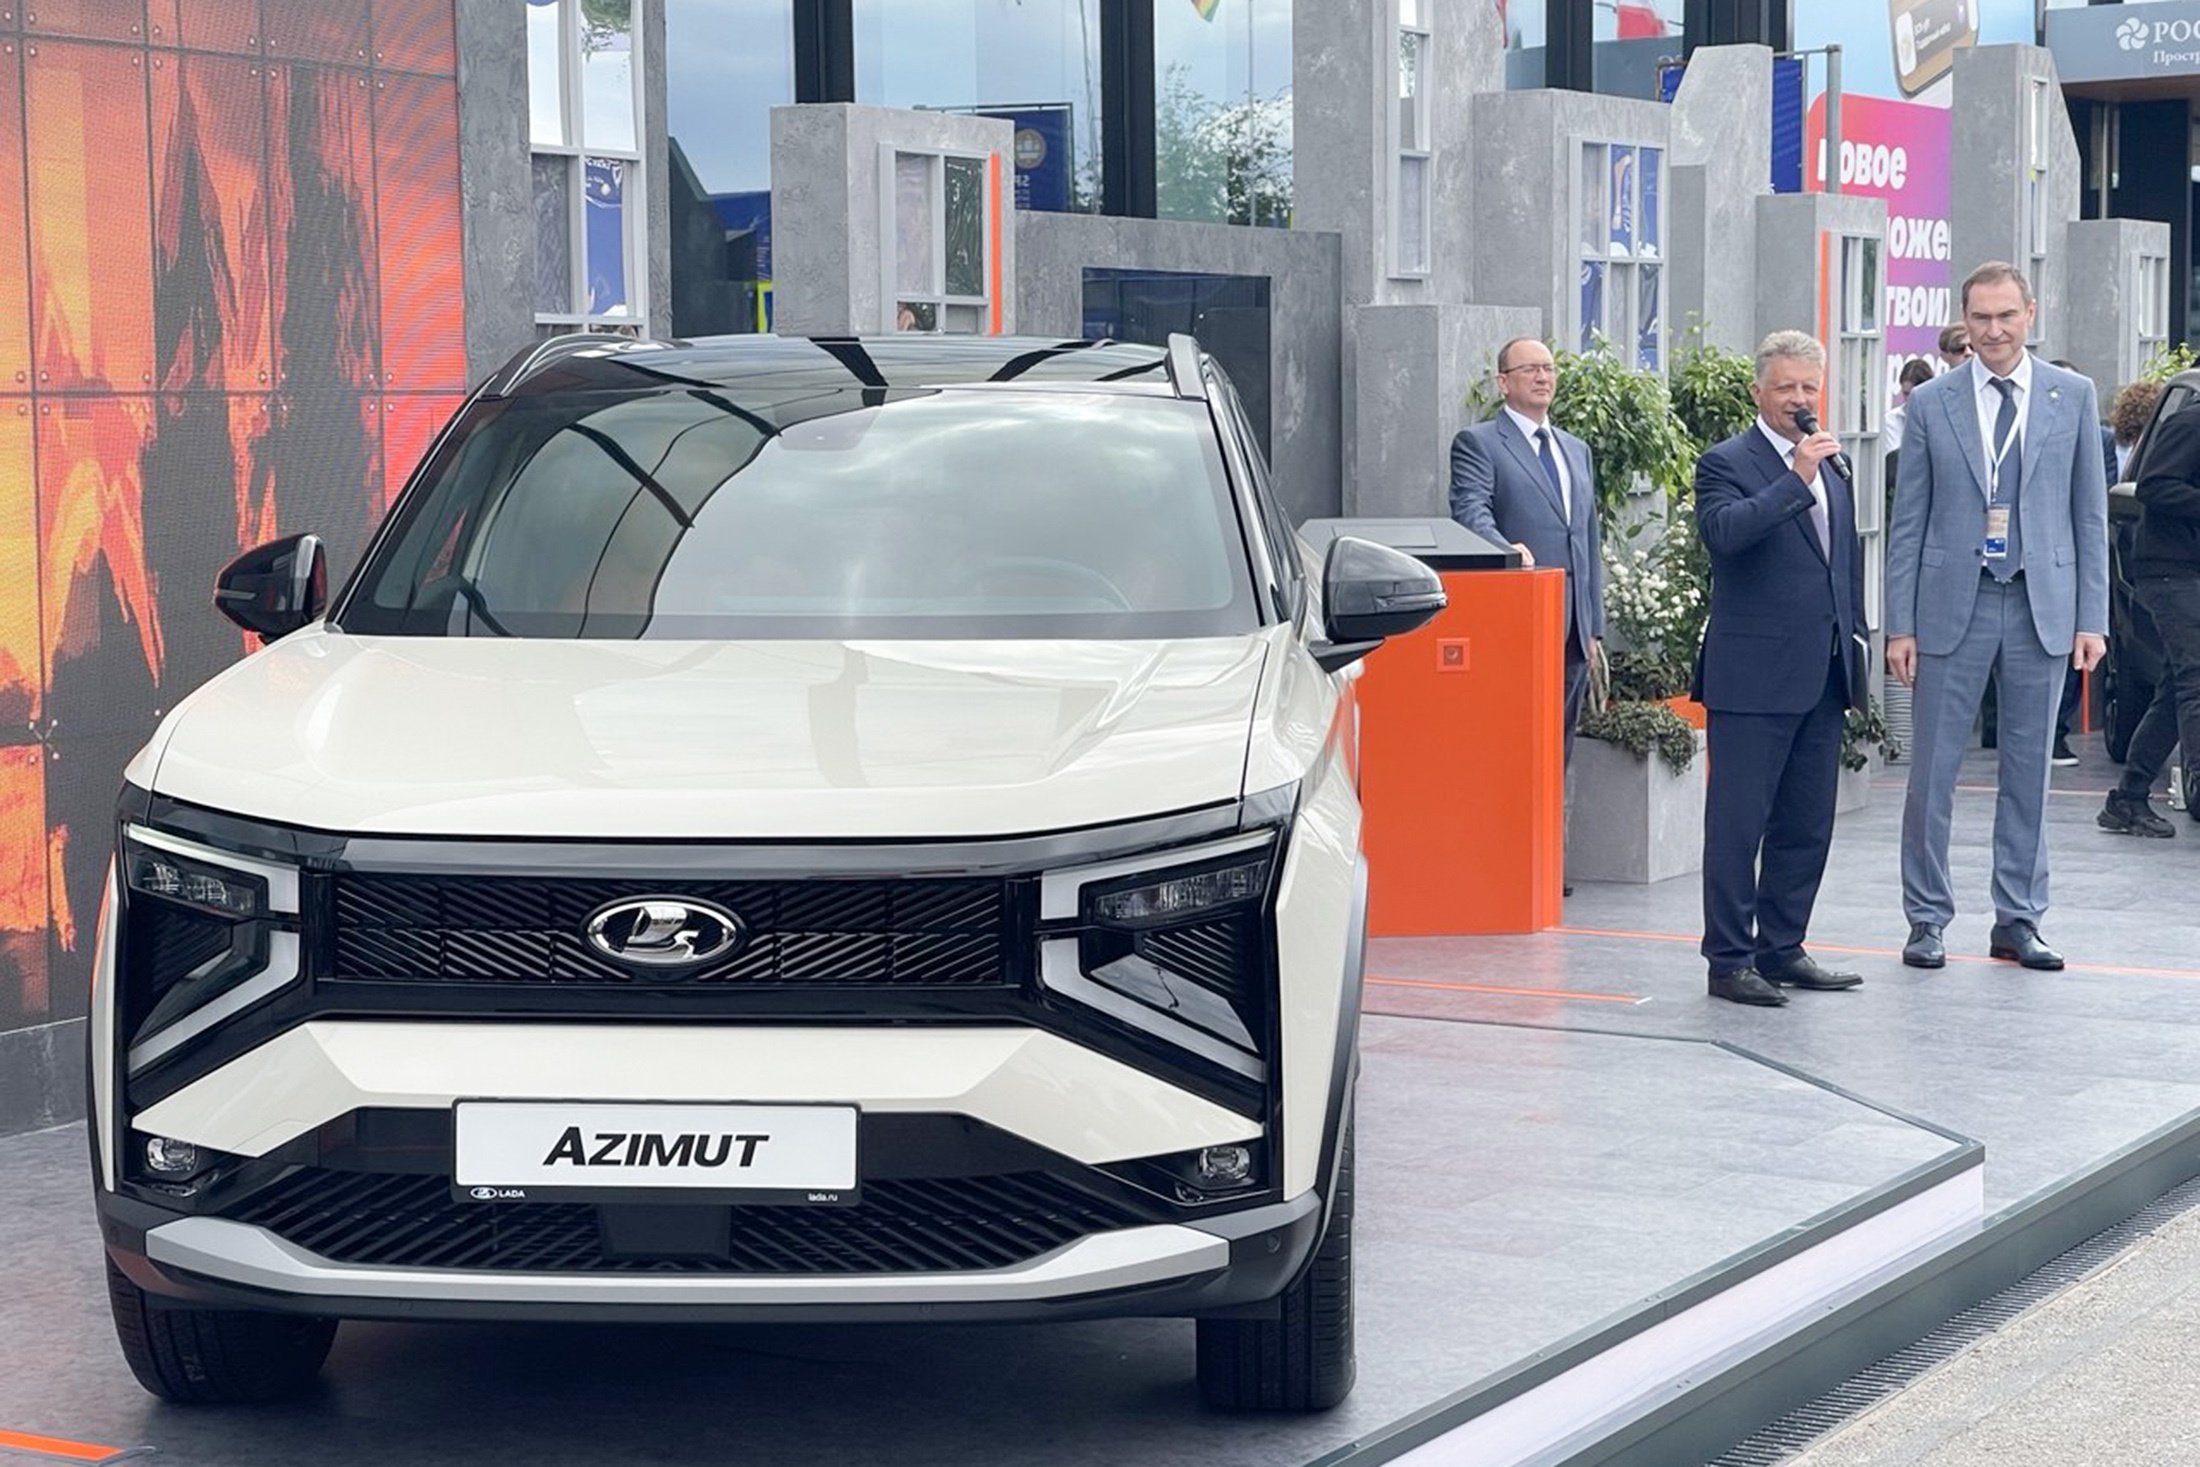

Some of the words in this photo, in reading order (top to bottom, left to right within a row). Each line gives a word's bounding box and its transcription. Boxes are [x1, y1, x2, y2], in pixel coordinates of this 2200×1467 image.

[1887, 215, 1951, 261] оже
[542, 1126, 770, 1167] AZIMUT
[499, 1189, 525, 1198] LADA
